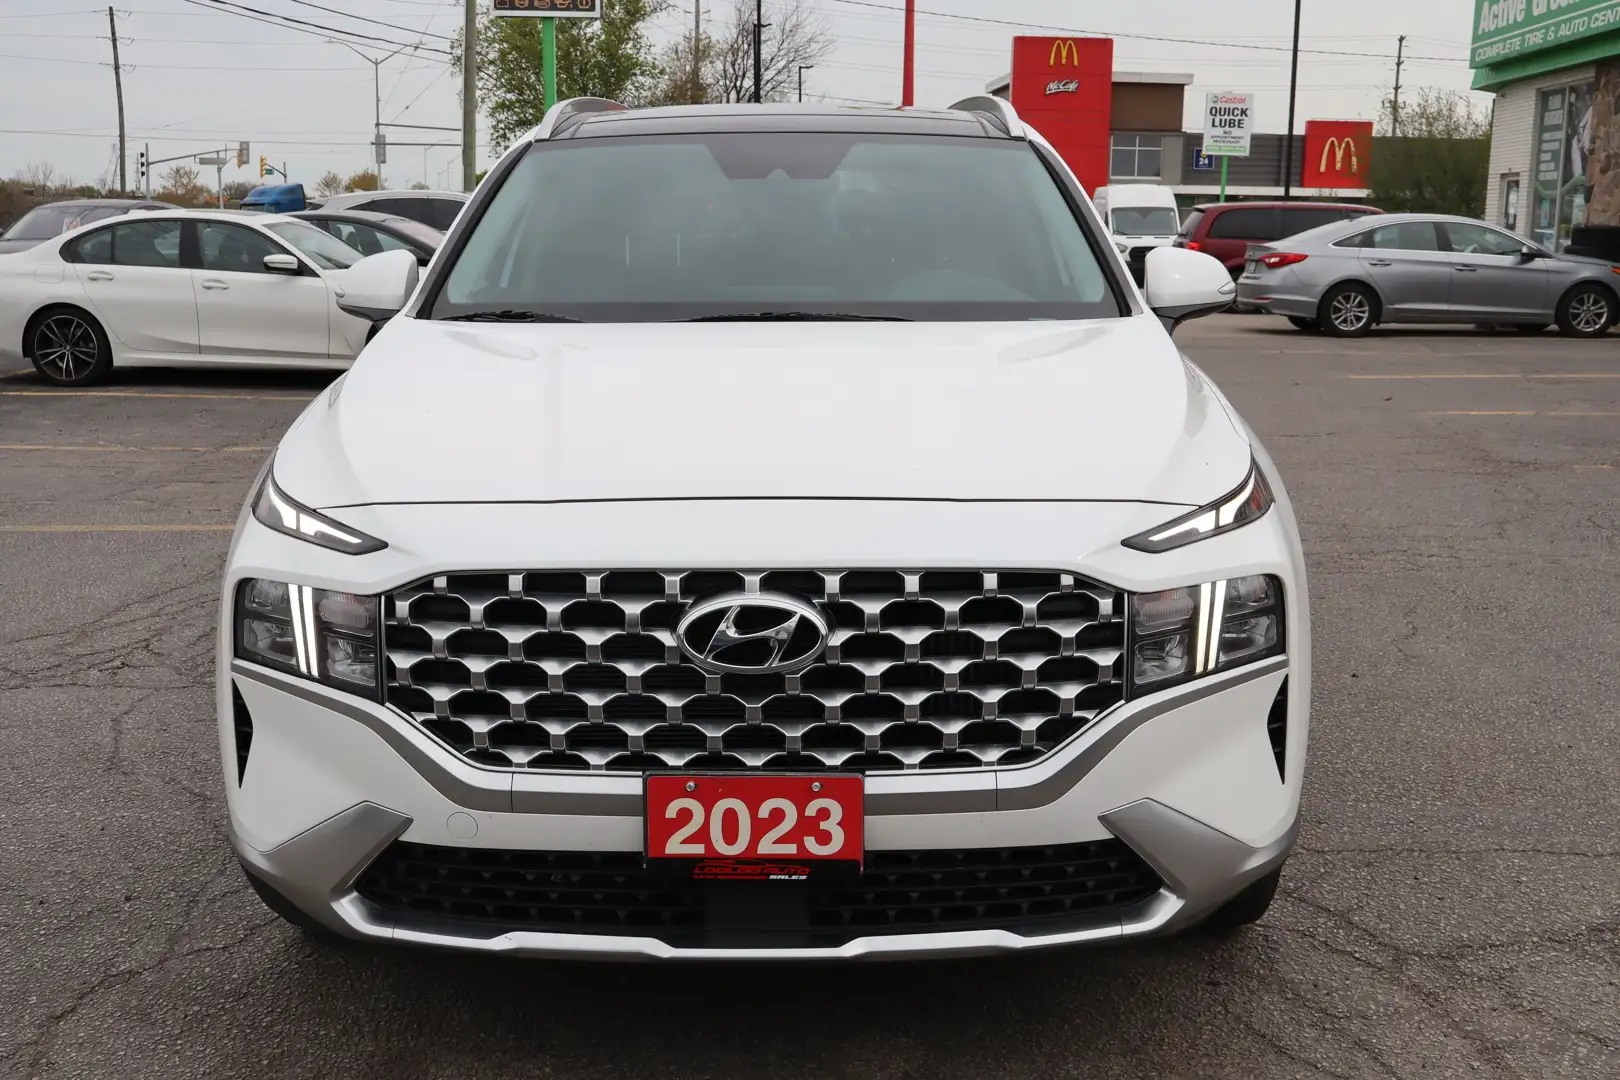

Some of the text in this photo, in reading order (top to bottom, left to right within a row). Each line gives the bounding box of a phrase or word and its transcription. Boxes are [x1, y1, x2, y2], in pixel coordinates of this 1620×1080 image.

[1478, 0, 1526, 35] Active
[1475, 36, 1522, 61] COMPLETE
[1524, 29, 1546, 47] TIRE
[1547, 27, 1555, 40] &
[1557, 17, 1589, 37] AUTO
[1219, 96, 1247, 104] Castrol
[1209, 106, 1249, 117] QUICK
[1211, 117, 1245, 128] LUBE
[1198, 157, 1209, 165] 24
[664, 797, 845, 856] 2023
[763, 867, 811, 875] AUTO
